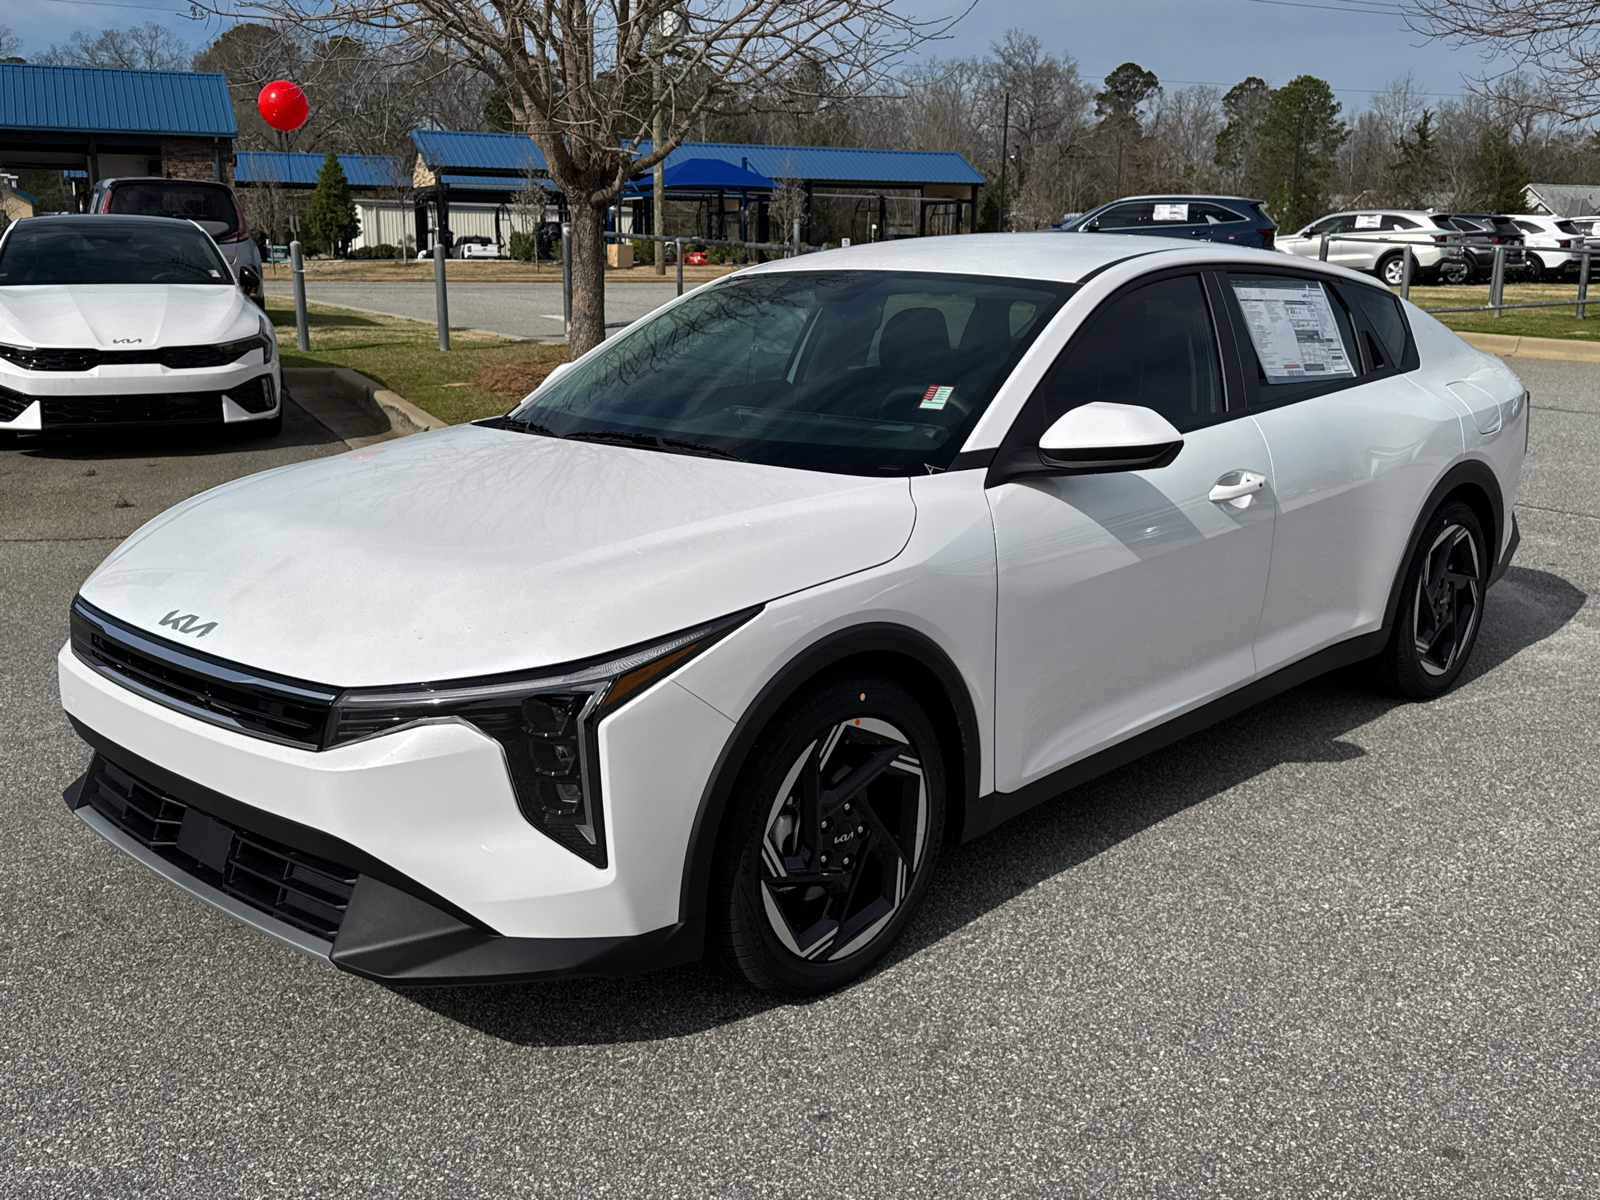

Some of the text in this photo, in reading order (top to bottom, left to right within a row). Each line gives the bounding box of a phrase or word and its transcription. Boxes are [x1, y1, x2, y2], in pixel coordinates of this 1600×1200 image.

[158, 609, 219, 639] KIA
[740, 792, 766, 876] KUMHO
[834, 830, 854, 844] KIA
